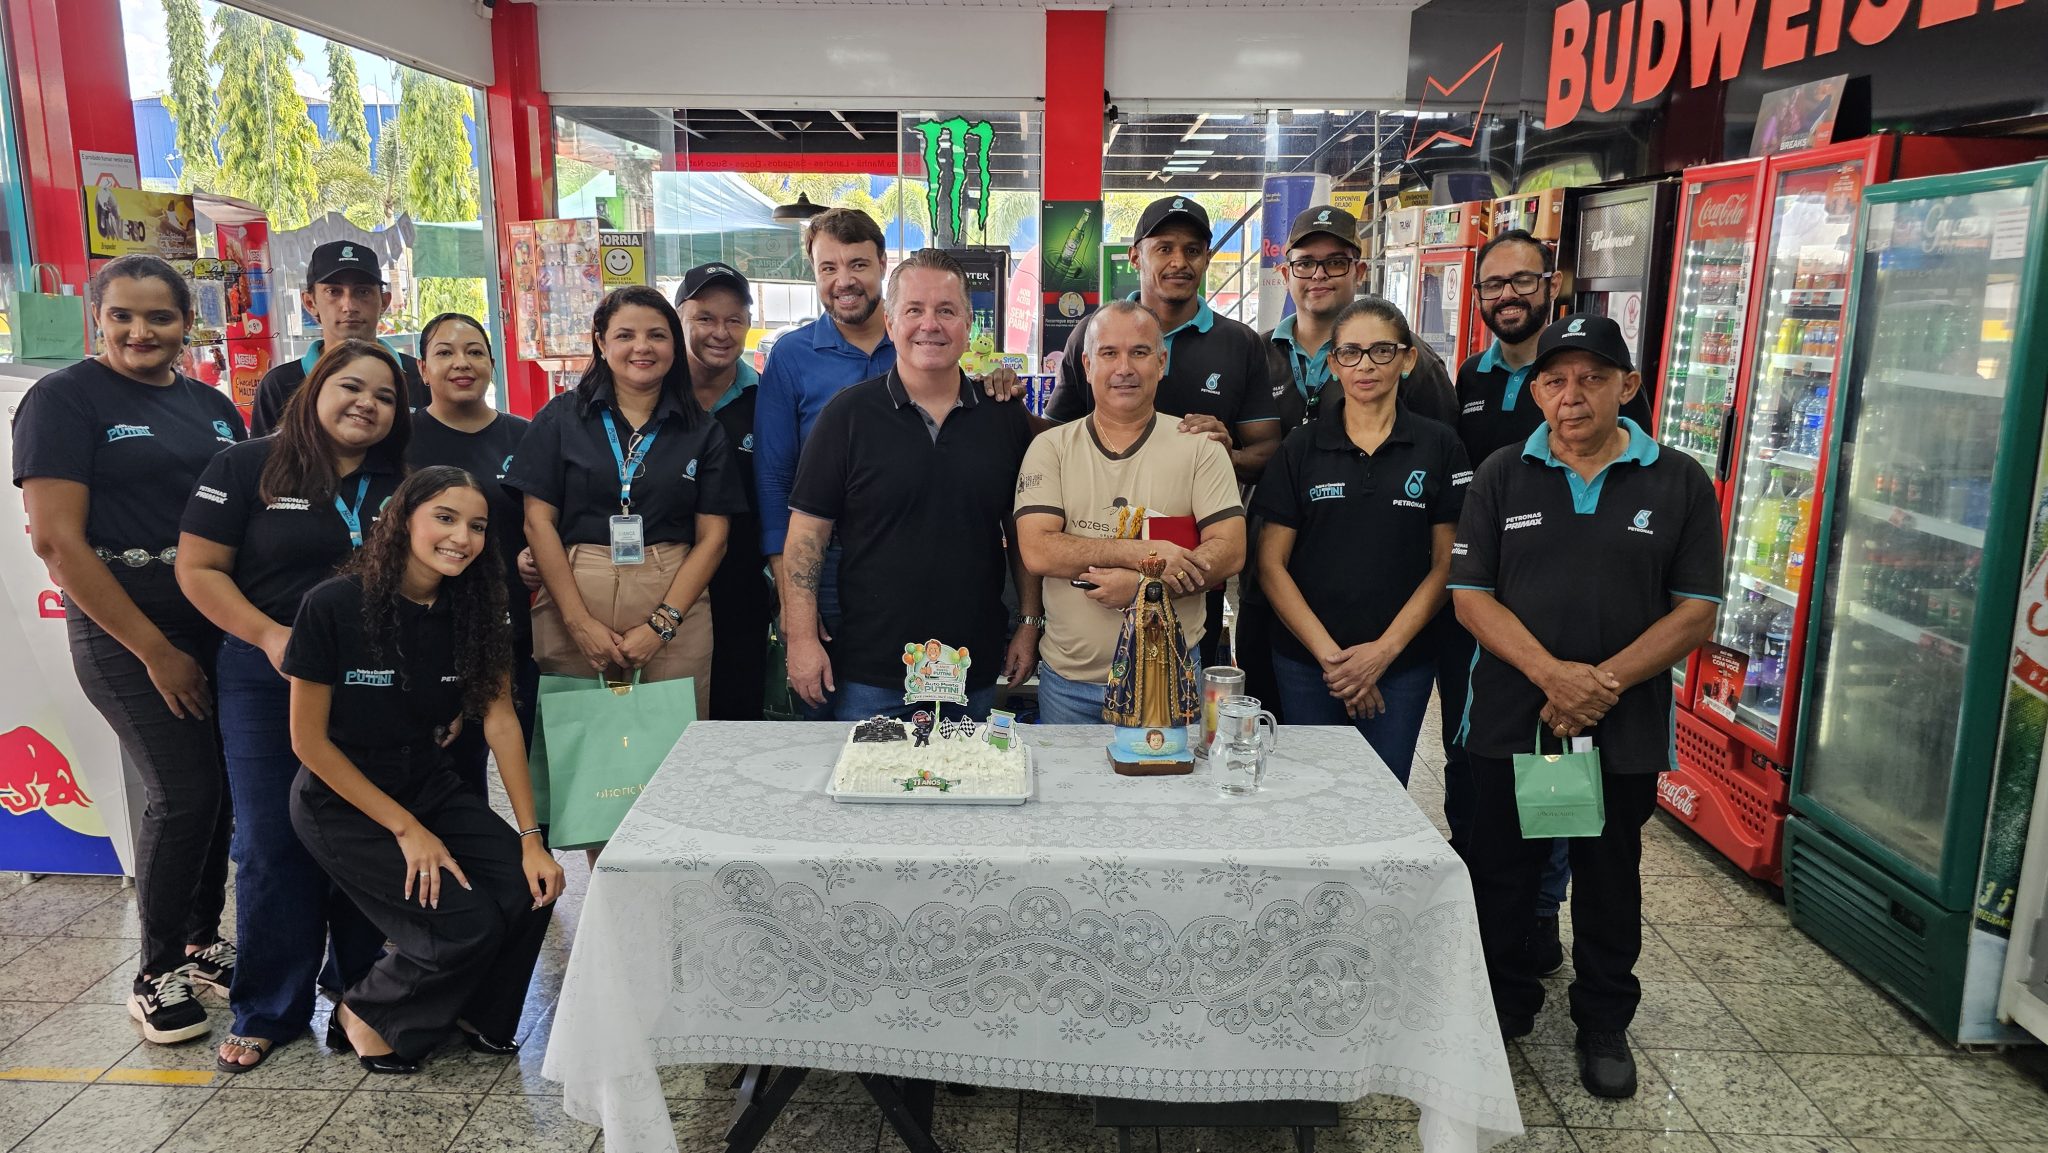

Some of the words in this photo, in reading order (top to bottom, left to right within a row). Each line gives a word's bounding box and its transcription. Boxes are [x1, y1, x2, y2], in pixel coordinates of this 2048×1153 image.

[1780, 138, 1808, 151] BREAKS
[1697, 193, 1748, 228] Coca-Cola
[1590, 231, 1636, 252] Budweiser
[234, 353, 258, 366] Nestlé
[107, 427, 151, 440] PUTTINI
[1309, 486, 1343, 499] PUTTINI
[1392, 499, 1427, 509] PETRONAS
[1504, 516, 1544, 531] PRIMAX
[1506, 511, 1542, 524] PETRONAS
[1627, 526, 1654, 535] PETRONAS
[345, 670, 392, 684] PUTTINI
[924, 685, 959, 694] PUTTINI
